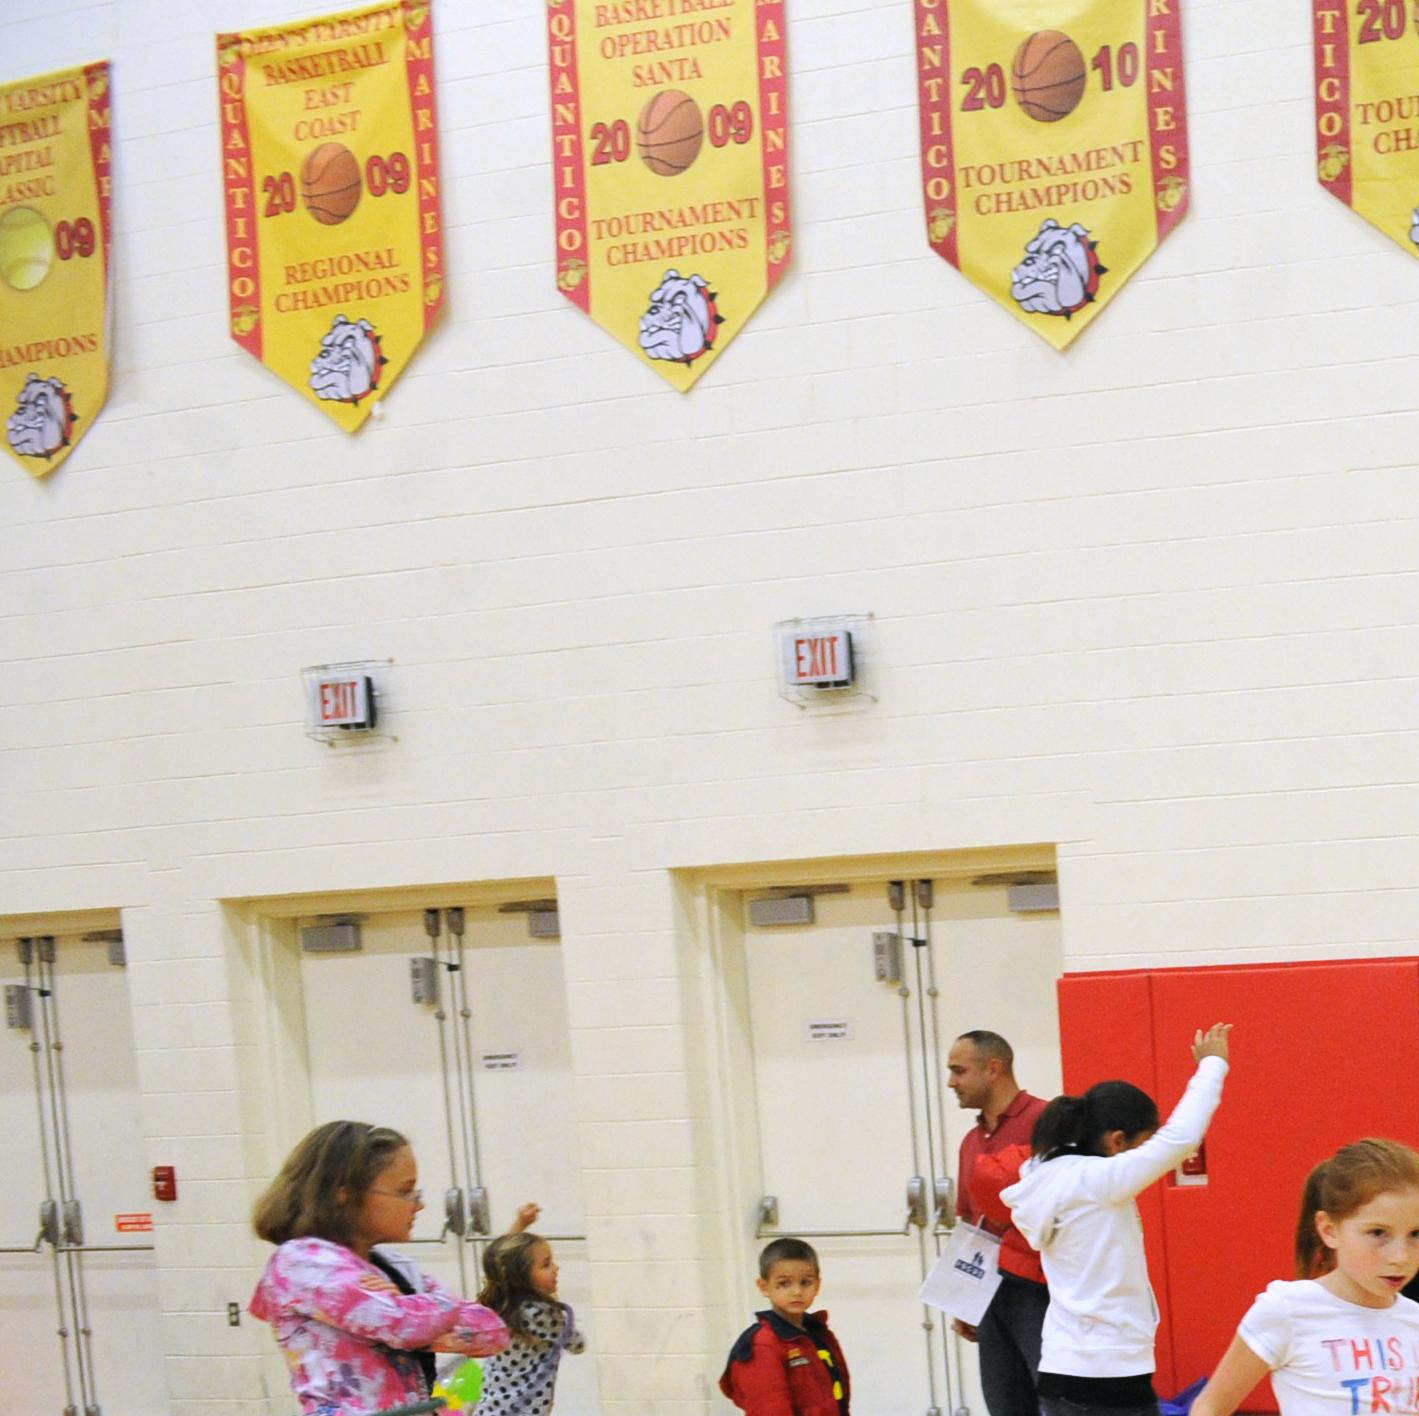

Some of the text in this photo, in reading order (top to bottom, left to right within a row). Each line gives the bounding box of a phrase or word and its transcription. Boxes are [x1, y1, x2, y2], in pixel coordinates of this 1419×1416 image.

[600, 17, 732, 60] OPERATION
[262, 42, 391, 86] BASKETBALL
[632, 57, 704, 88] SANTA
[960, 41, 1139, 112] 20 10
[302, 81, 355, 110] EAST
[756, 0, 785, 225] ARINES
[294, 110, 361, 141] COAST
[551, 13, 582, 251] QUANTICO
[590, 100, 753, 166] 20 09
[406, 37, 439, 268] MARINES
[958, 140, 1145, 189] TOURNAMENT
[221, 73, 256, 297] QUANTICO
[262, 152, 411, 217] 20 09
[974, 173, 1133, 216] CHAMPIONS
[55, 217, 96, 261] 09
[591, 197, 760, 241] TOURNAMENT
[284, 248, 401, 286] REGIONAL
[606, 228, 749, 267] CHAMPIONS
[274, 273, 411, 313] CHAMPIONS
[0, 333, 97, 369] AMPIONS
[794, 636, 838, 678] EXIT
[320, 681, 357, 720] EXIT
[1320, 1336, 1405, 1372] THIS
